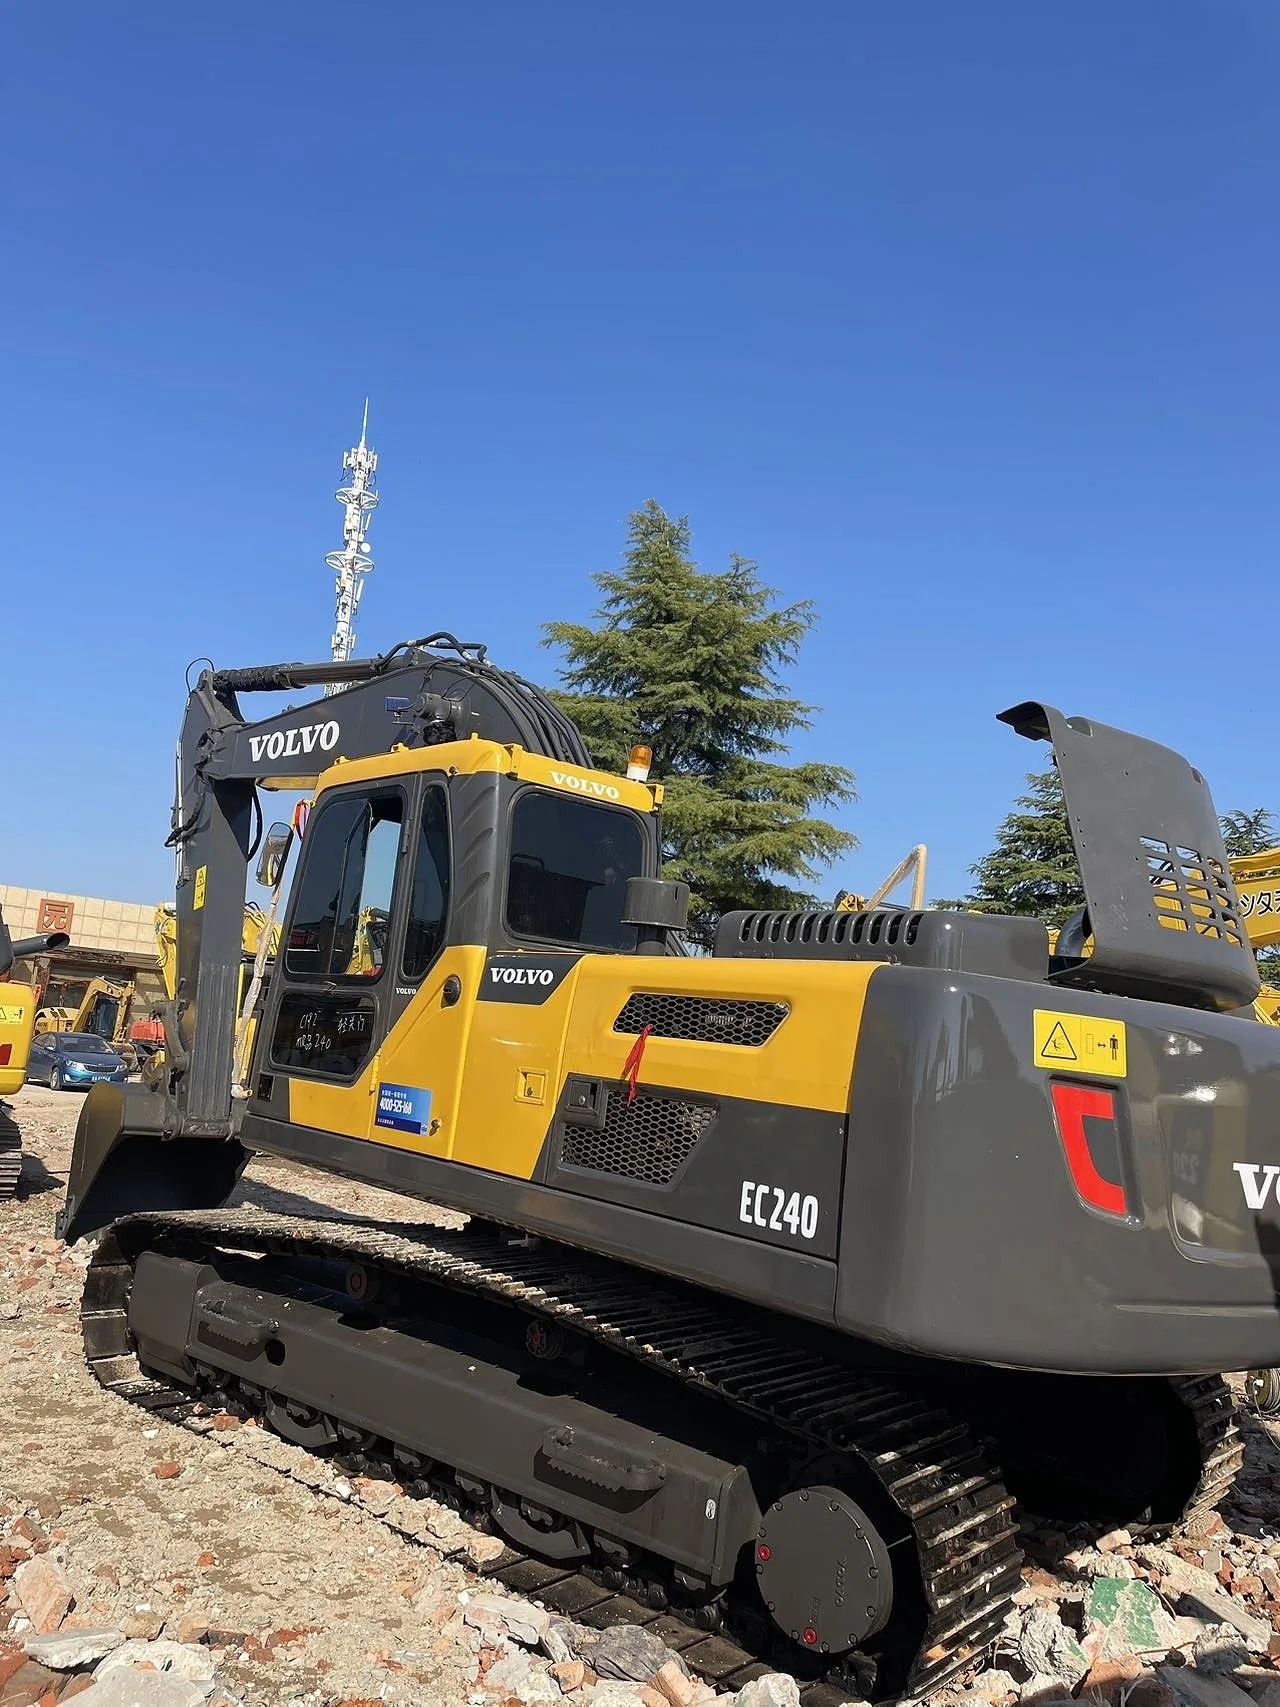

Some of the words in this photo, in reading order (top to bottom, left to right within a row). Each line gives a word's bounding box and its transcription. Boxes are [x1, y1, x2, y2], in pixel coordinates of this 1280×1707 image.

[249, 720, 340, 762] VOLVO
[549, 770, 620, 800] VOLVO
[395, 987, 417, 995] VOLVO
[490, 967, 554, 986] VOLVO
[1233, 1162, 1280, 1210] V
[740, 1180, 819, 1239] EC240
